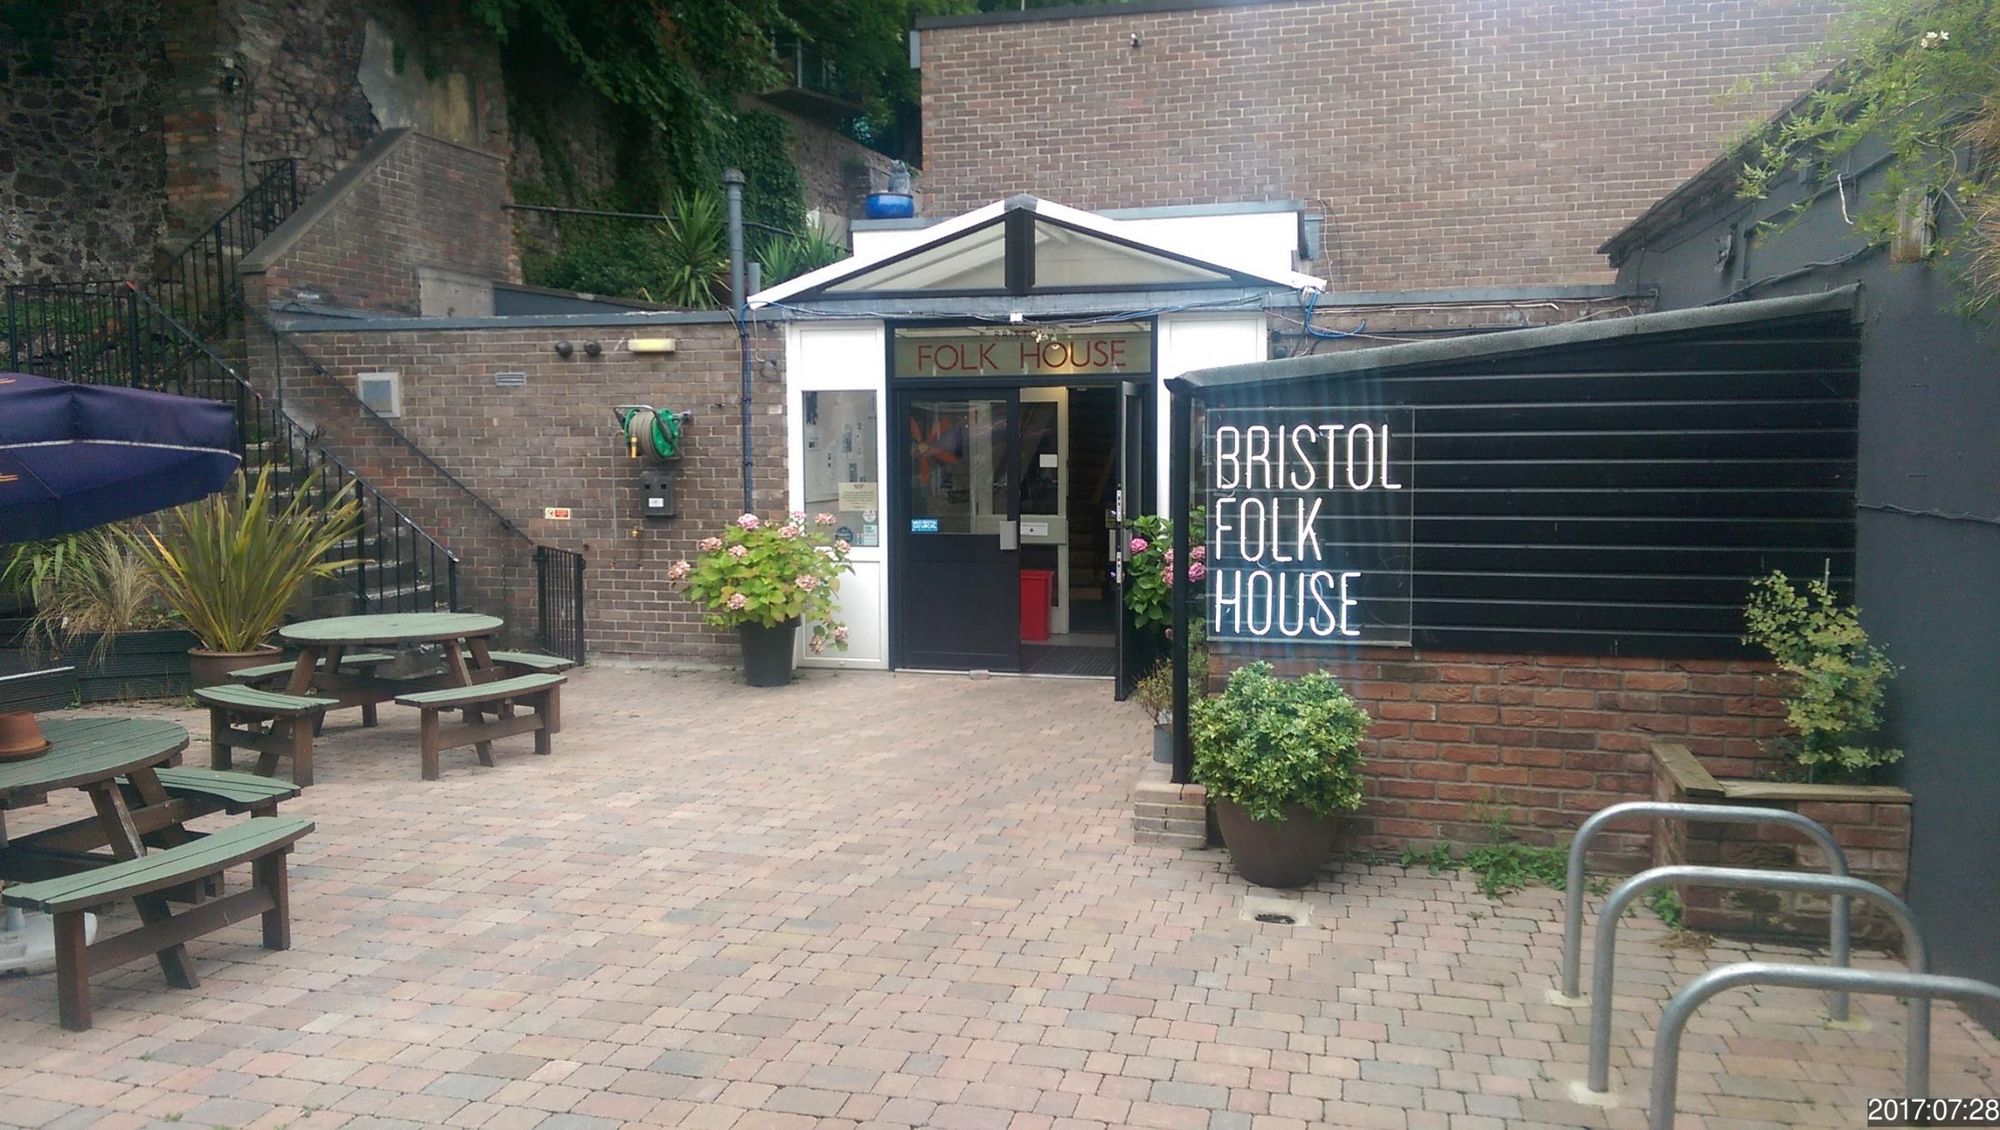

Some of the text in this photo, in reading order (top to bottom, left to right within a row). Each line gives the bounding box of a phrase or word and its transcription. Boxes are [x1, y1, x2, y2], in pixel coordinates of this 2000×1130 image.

[918, 341, 1126, 371] FOLK HOUSE
[1216, 424, 1402, 490] BRISTOL
[1215, 497, 1322, 562] FOLK
[1215, 569, 1362, 637] HOUSE
